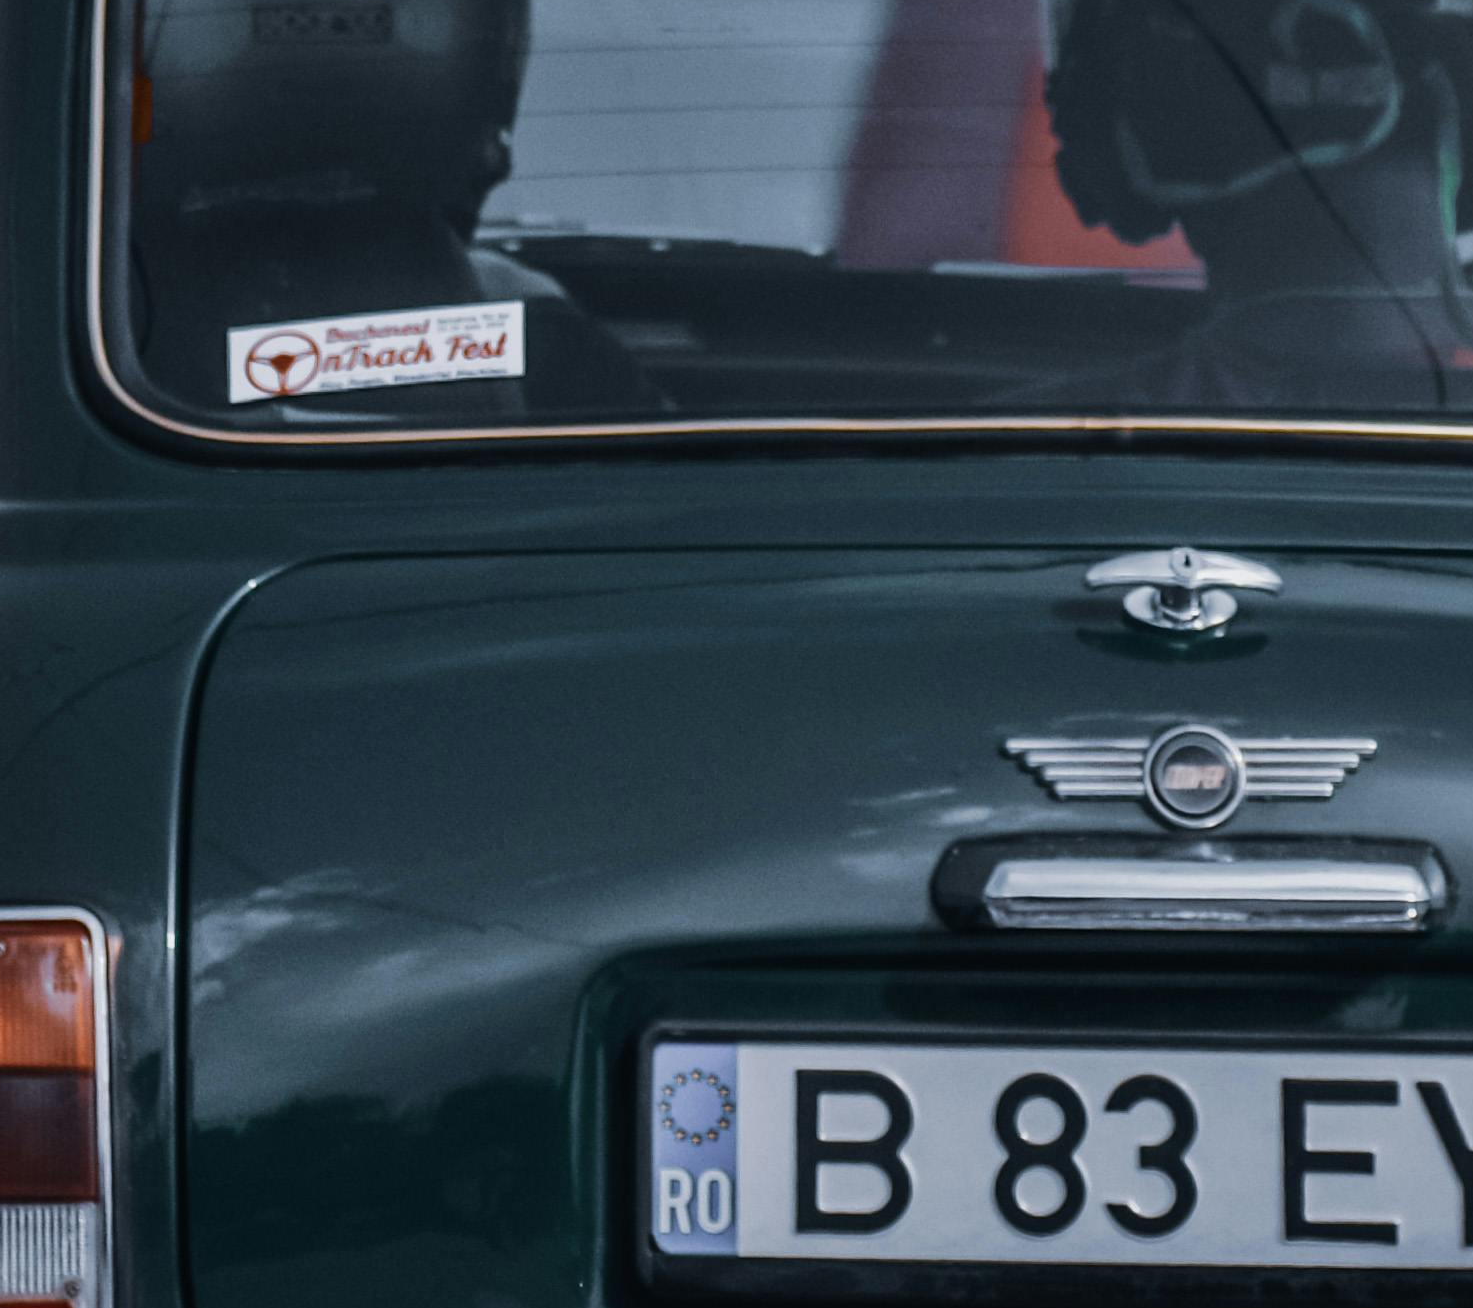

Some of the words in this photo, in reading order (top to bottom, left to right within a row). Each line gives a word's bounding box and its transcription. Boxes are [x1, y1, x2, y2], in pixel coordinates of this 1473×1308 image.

[658, 1168, 732, 1236] RO
[794, 1068, 915, 1237] B
[994, 1071, 1199, 1239] 83
